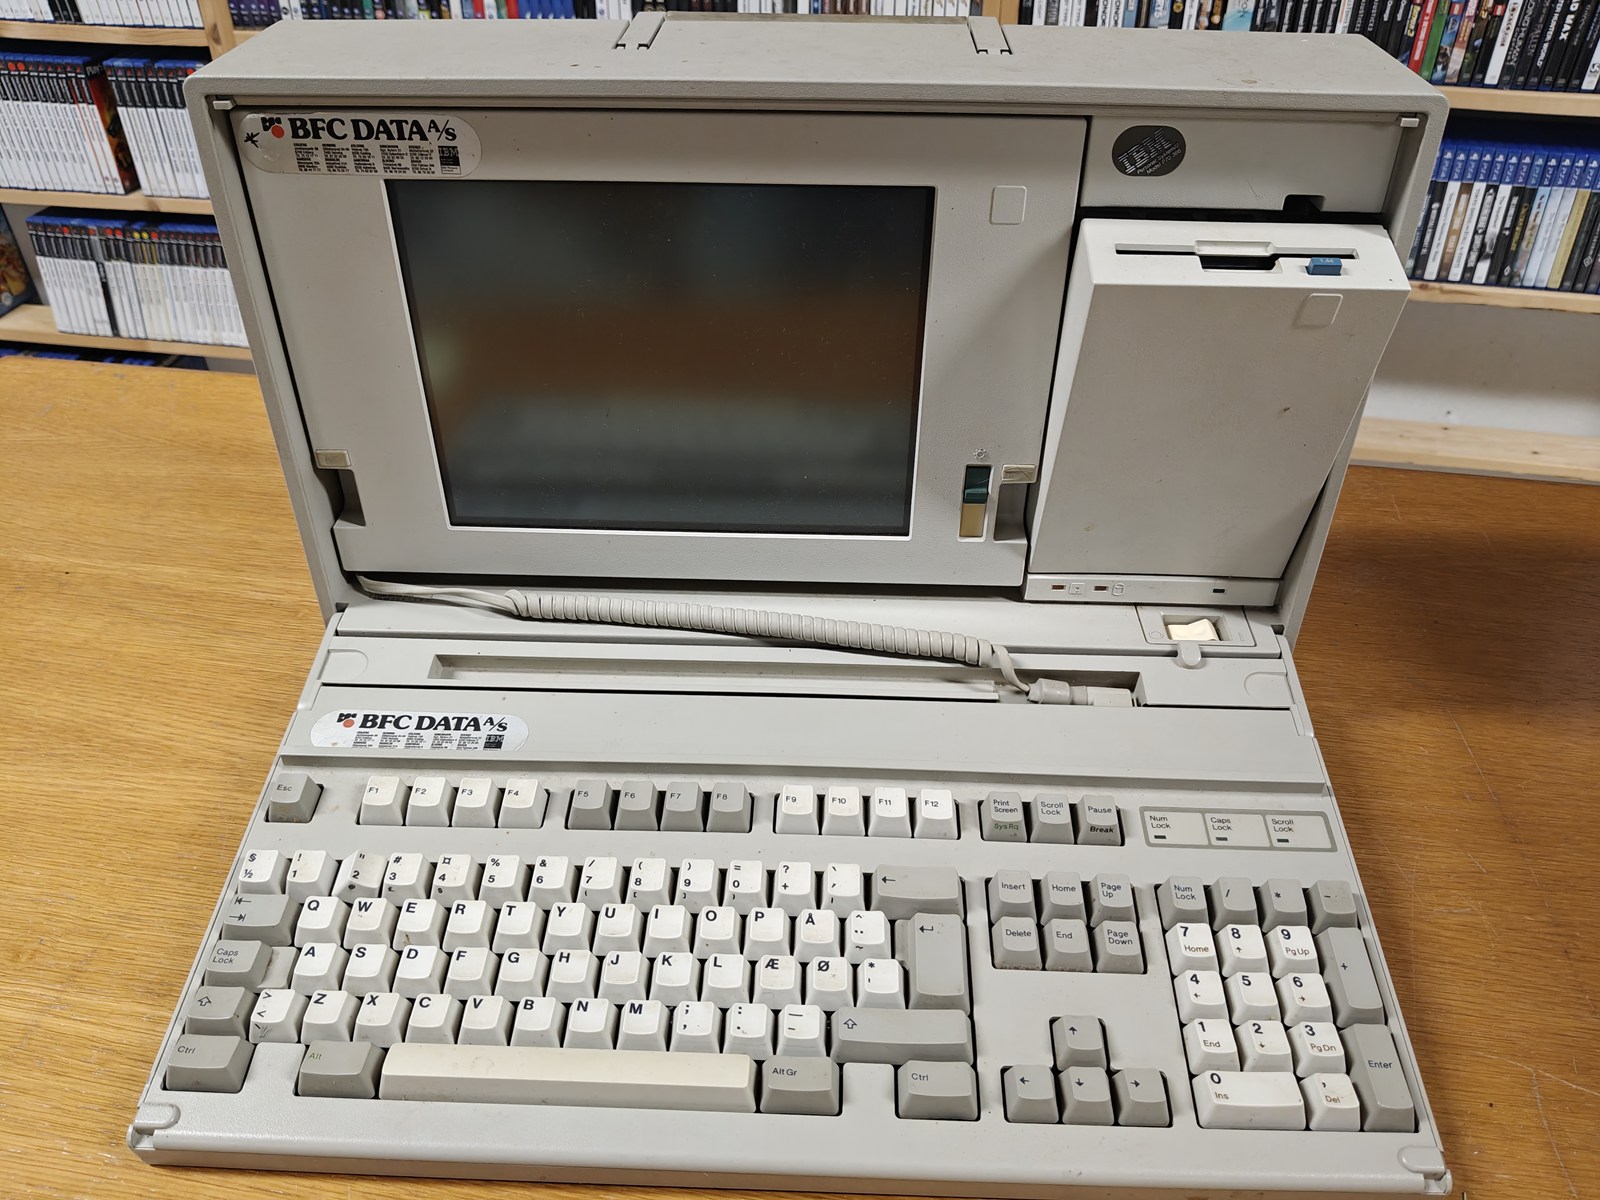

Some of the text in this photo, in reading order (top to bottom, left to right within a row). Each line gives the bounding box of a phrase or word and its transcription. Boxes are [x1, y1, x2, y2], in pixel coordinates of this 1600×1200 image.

[1559, 14, 1575, 41] MAX
[1528, 23, 1543, 56] FALLEN
[288, 117, 347, 139] BFC
[350, 118, 428, 141] DATA
[438, 148, 459, 157] IBM
[1118, 128, 1171, 174] IBM
[1137, 158, 1157, 174] Personal
[1147, 162, 1161, 174] Model
[1441, 160, 1449, 177] PS4
[1453, 161, 1462, 179] PS4
[1466, 161, 1476, 179] PS4
[1479, 162, 1488, 180] PS4
[1492, 163, 1501, 180] PS4
[1505, 165, 1514, 182] PS4
[1518, 165, 1527, 182] PS4
[1531, 166, 1540, 184] PS4
[1544, 167, 1552, 184] PS4
[1558, 167, 1566, 184] PS4
[1570, 168, 1580, 186] PS4
[1584, 169, 1594, 186] PS4
[359, 714, 412, 729] BFC
[414, 716, 482, 732] DATA
[484, 735, 504, 743] IBM
[277, 784, 292, 792] Esc
[461, 788, 473, 796] F3
[786, 795, 797, 803] F9
[832, 797, 847, 805] F10
[878, 798, 892, 806] F11
[924, 800, 939, 808] F12
[993, 799, 1010, 807] Print
[994, 806, 1018, 814] Screen
[1040, 801, 1064, 809] Scroll
[1088, 806, 1112, 814] Pause
[1041, 808, 1061, 816] Lock
[1271, 818, 1294, 826] Scroll
[1089, 826, 1114, 834] Break
[292, 870, 297, 878] 1
[352, 870, 360, 879] 2
[389, 872, 396, 880] 3
[438, 873, 446, 882] 4
[487, 875, 495, 883] 5
[536, 875, 544, 884] 6
[585, 876, 592, 884] 7
[634, 877, 642, 886] 8
[684, 878, 691, 887] 9
[732, 880, 740, 888] 0
[1001, 882, 1026, 890] Insert
[1052, 884, 1076, 892] Home
[1101, 882, 1122, 891] Page
[1102, 890, 1114, 898] Up
[1175, 892, 1196, 900] Lock
[307, 900, 320, 911] Q
[357, 901, 373, 912] W
[405, 902, 418, 913] E
[455, 903, 466, 914] R
[506, 905, 516, 916] T
[556, 906, 566, 917] Y
[604, 907, 616, 919] U
[654, 908, 659, 919] I
[754, 911, 764, 922] P
[805, 912, 816, 925] Å
[1005, 929, 1032, 937] Delete
[1056, 931, 1072, 939] End
[1107, 930, 1128, 938] Page
[1180, 926, 1189, 937] 7
[1231, 928, 1241, 939] 8
[1280, 928, 1291, 940] 9
[1108, 937, 1133, 945] Down
[216, 948, 239, 957] Caps
[304, 946, 316, 957] A
[355, 946, 367, 958] S
[406, 948, 419, 960] D
[455, 950, 467, 961] F
[213, 956, 234, 964] Lock
[507, 951, 520, 964] G
[558, 952, 570, 964] H
[610, 954, 620, 965] J
[661, 954, 673, 966] K
[713, 956, 722, 968] L
[764, 958, 780, 970] Æ
[817, 960, 830, 972] Ø
[1190, 974, 1200, 985] 4
[1241, 975, 1252, 986] 5
[1292, 976, 1303, 988] 6
[314, 993, 327, 1004] Z
[366, 995, 379, 1006] X
[419, 997, 431, 1008] C
[473, 998, 484, 1009] V
[523, 999, 534, 1010] B
[576, 1001, 589, 1012] N
[629, 1003, 644, 1015] M
[1198, 1021, 1206, 1032] 1
[1252, 1023, 1264, 1034] 2
[1304, 1025, 1316, 1036] 3
[177, 1045, 196, 1054] Ctrl
[1203, 1040, 1221, 1048] End
[308, 1052, 322, 1060] Alt
[1368, 1060, 1392, 1069] Enter
[772, 1068, 797, 1077] Alt Gr
[911, 1072, 929, 1082] Ctrl
[1210, 1072, 1222, 1084] 0
[1215, 1092, 1230, 1100] Ins
[1325, 1095, 1341, 1104] Del
